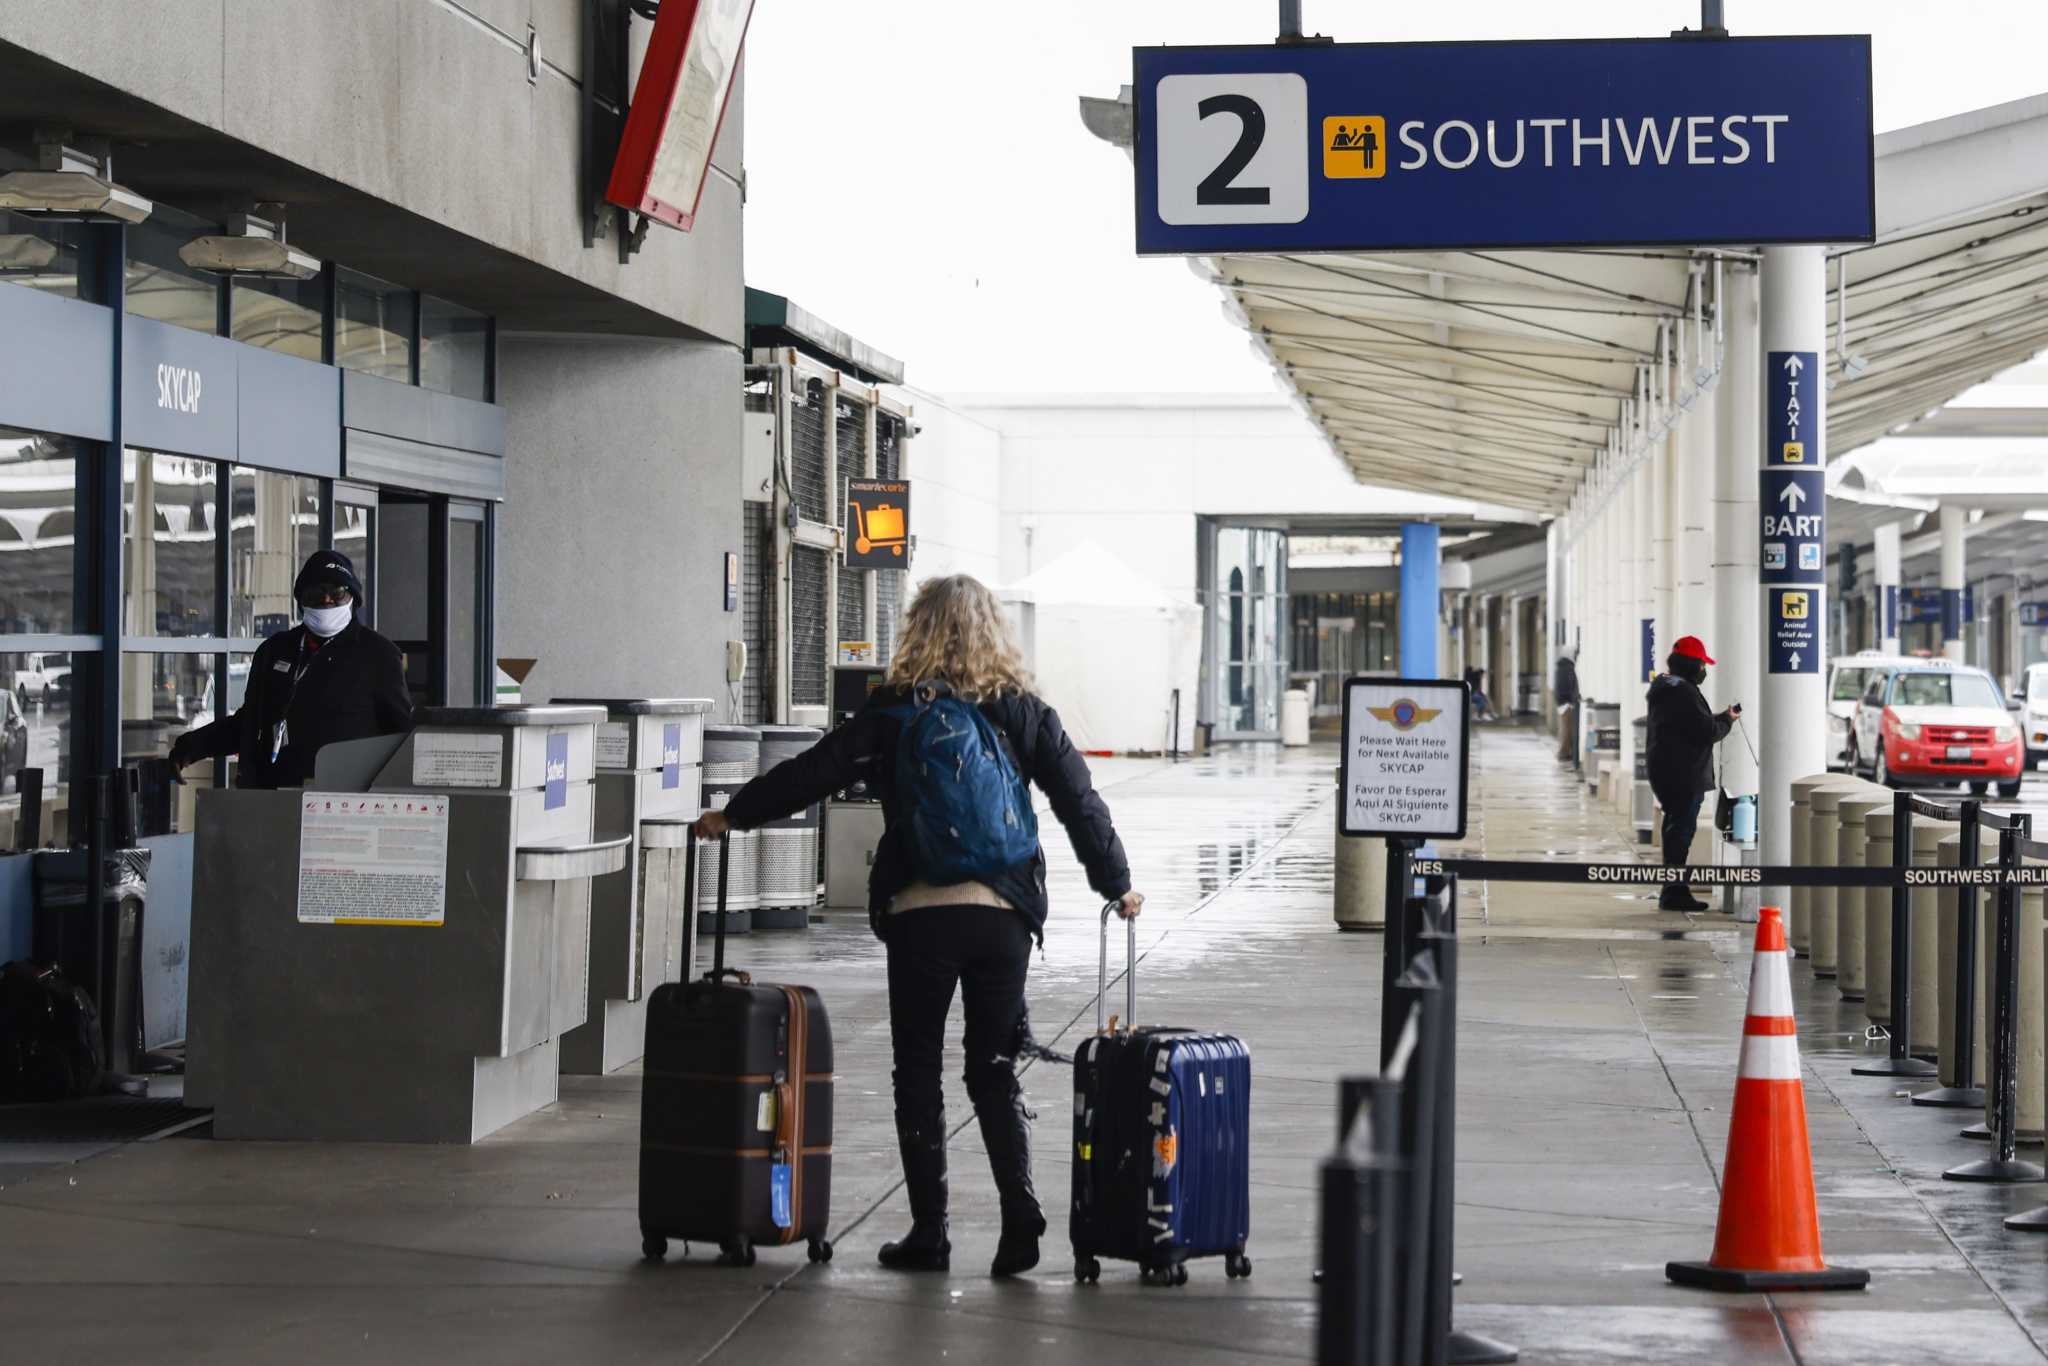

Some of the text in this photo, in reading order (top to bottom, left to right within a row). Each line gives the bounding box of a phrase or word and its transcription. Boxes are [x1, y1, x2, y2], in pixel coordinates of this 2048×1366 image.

[1196, 94, 1789, 205] 2 SOUTHWEST
[158, 363, 201, 415] SKYCAP
[1787, 381, 1800, 441] TAXI
[1764, 515, 1822, 537] BART
[1783, 622, 1808, 630] Animal
[1782, 640, 1808, 648] Outside
[1359, 735, 1446, 748] Please Wait Here
[1358, 747, 1449, 761] for Next Available
[1379, 763, 1425, 774] SKYCAP
[1355, 784, 1447, 798] Favor De Esperar
[1382, 799, 1393, 808] Al
[1395, 799, 1449, 812] Siguiente
[1378, 813, 1422, 824] SKYCAP
[1588, 866, 1761, 882] SOUTHWEST AIRLINES
[1904, 869, 2002, 884] SOUTHWEST
